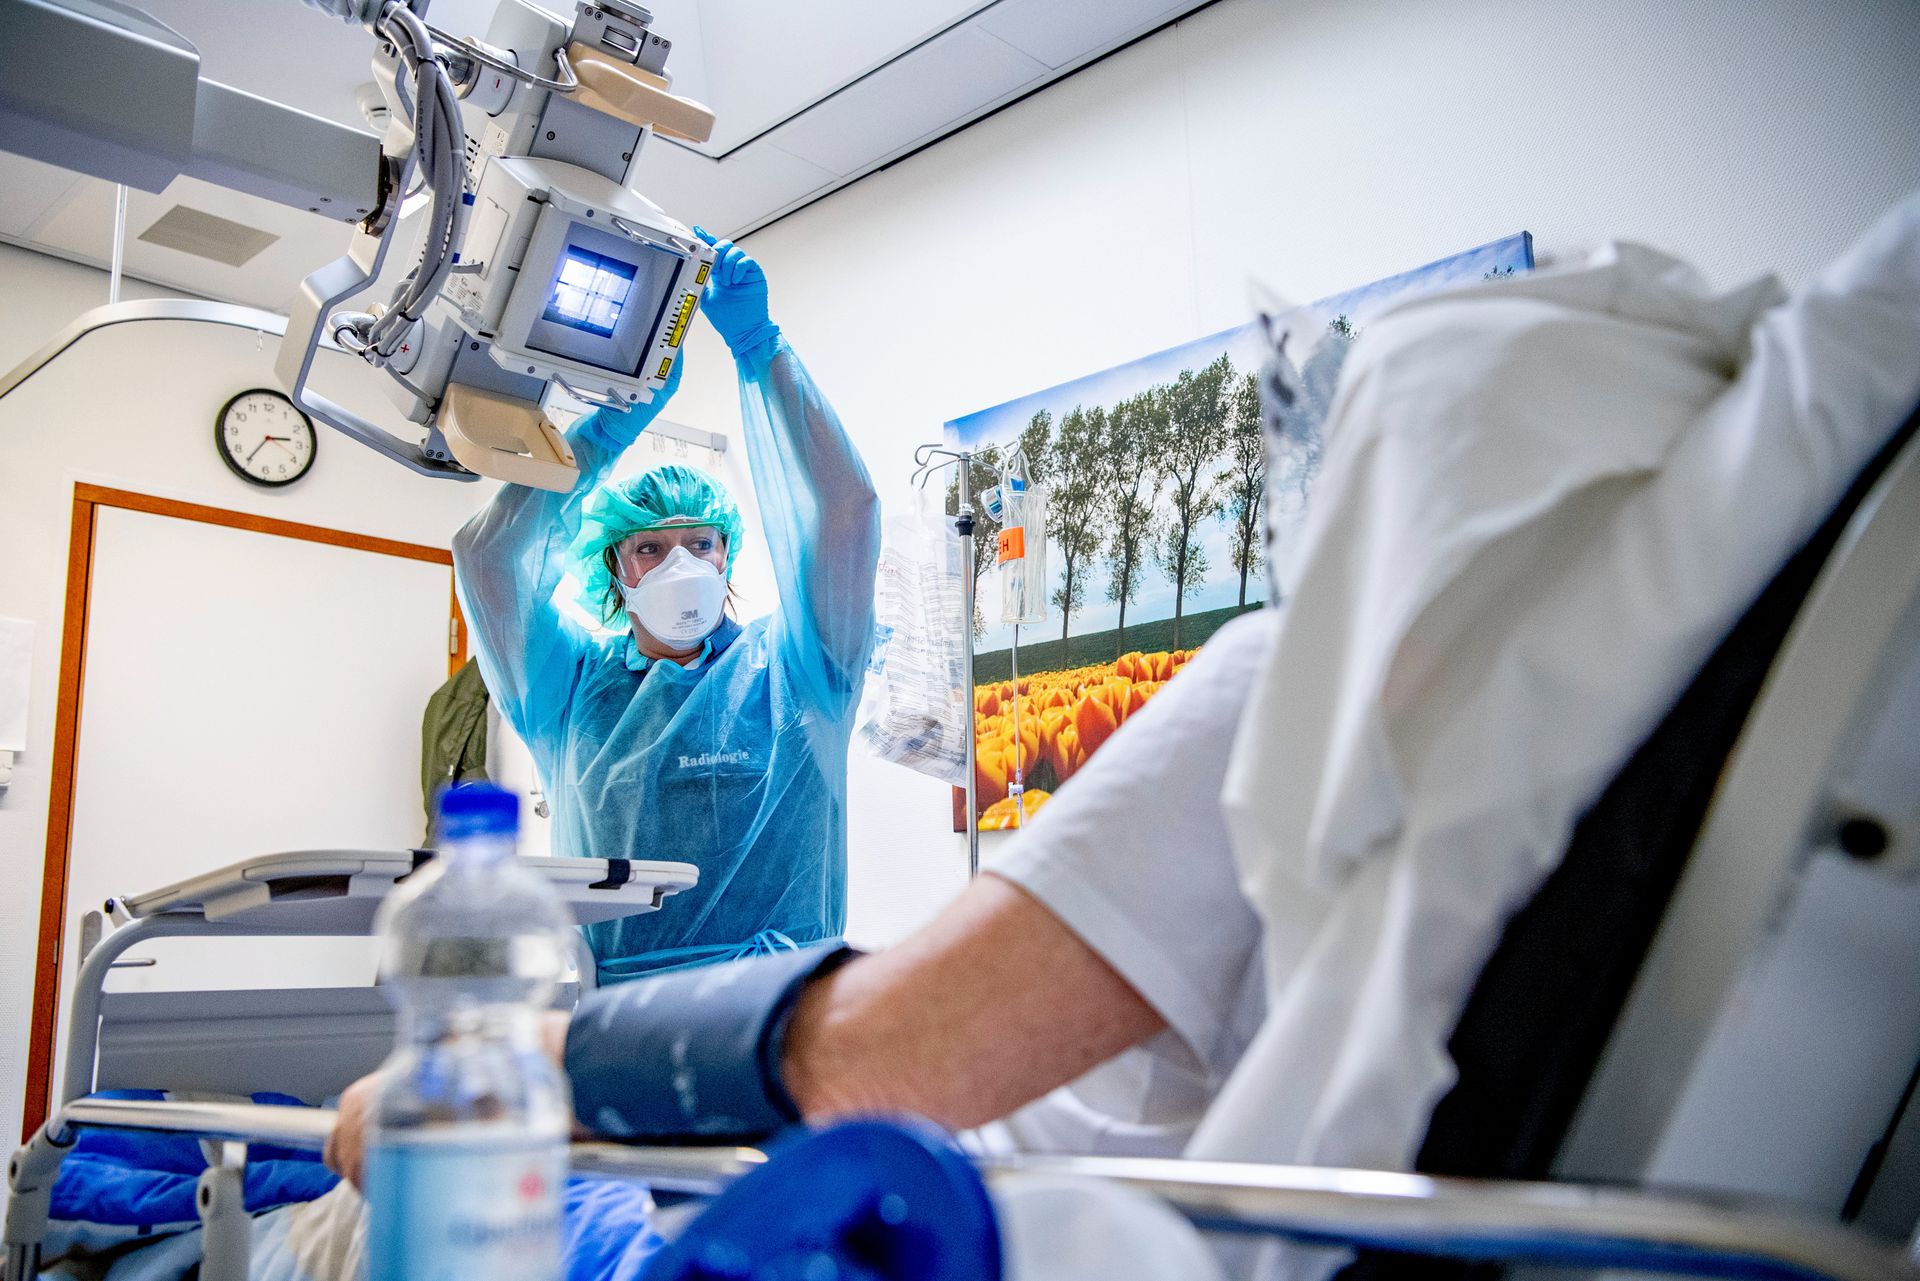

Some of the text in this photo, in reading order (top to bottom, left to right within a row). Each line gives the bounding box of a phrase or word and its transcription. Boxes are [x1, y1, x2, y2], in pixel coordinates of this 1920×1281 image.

[248, 403, 257, 413] 11
[264, 403, 275, 413] 12
[235, 411, 247, 422] 10
[230, 426, 239, 436] 9
[292, 424, 300, 434] 2
[234, 444, 242, 453] 8
[295, 441, 303, 450] 3
[290, 456, 297, 464] 4
[262, 465, 270, 475] 6
[279, 464, 286, 474] 5
[681, 609, 698, 620] 3M
[678, 749, 750, 768] Radiologie
